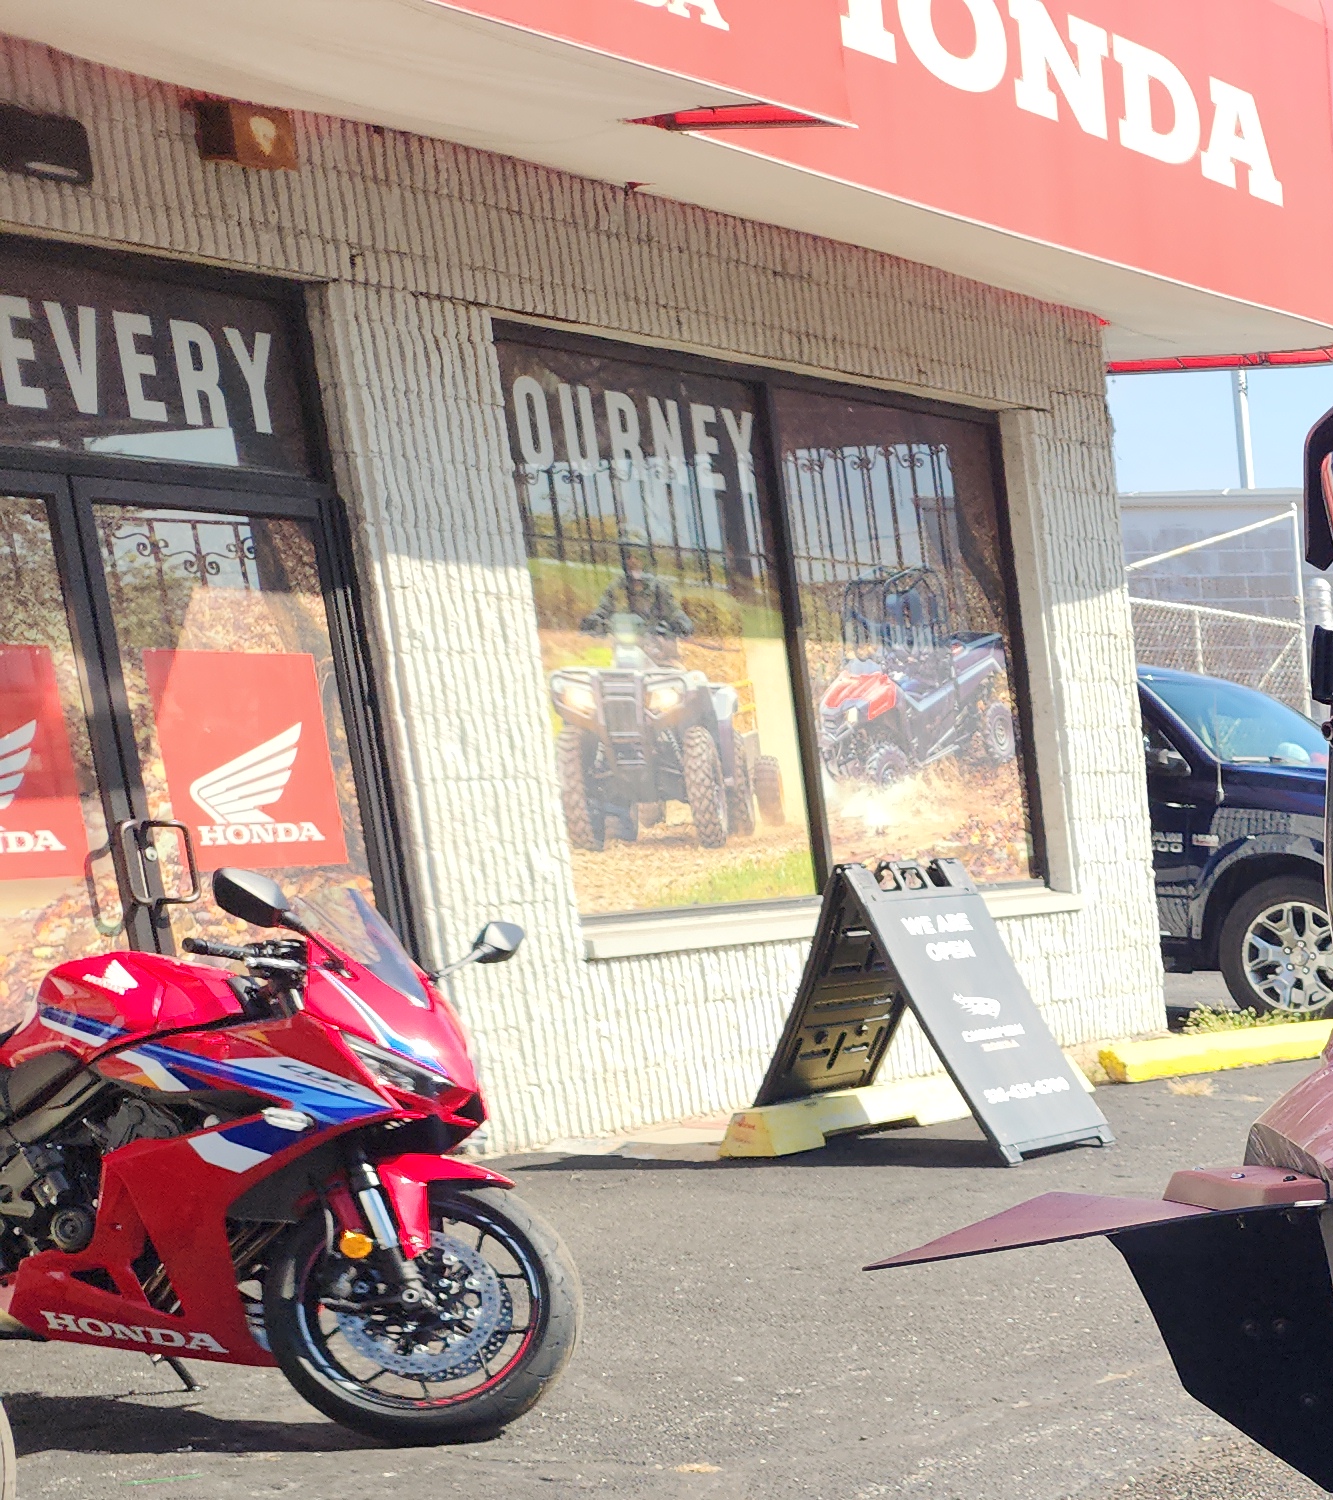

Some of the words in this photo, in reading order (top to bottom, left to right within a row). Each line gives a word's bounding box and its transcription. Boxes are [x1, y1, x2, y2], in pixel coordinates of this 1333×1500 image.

[0, 295, 273, 434] EVERY
[513, 376, 757, 497] OURNEY
[0, 826, 67, 853] DA
[197, 821, 326, 846] HONDA
[900, 916, 937, 935] WE
[926, 939, 976, 961] OPEN
[39, 1310, 229, 1354] HONDA
